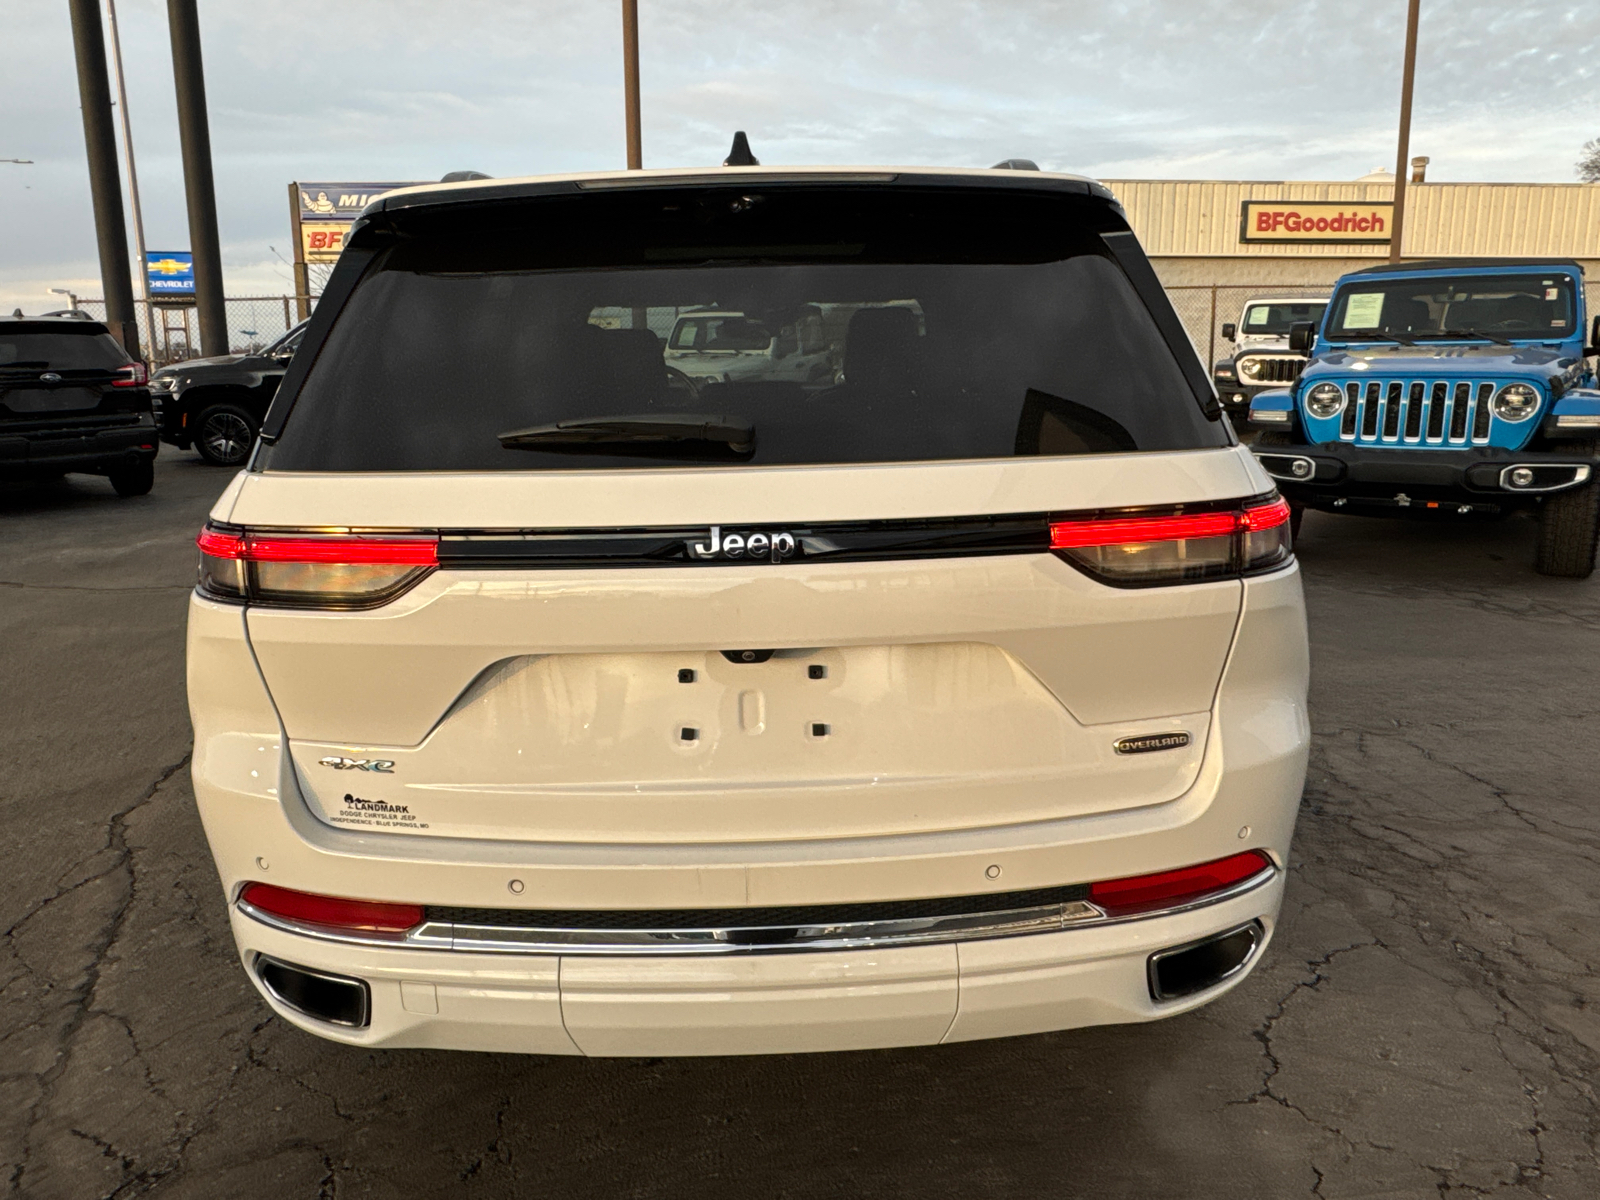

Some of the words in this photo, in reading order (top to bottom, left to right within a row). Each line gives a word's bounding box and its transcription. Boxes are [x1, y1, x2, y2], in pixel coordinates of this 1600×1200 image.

[1256, 211, 1384, 232] BFGoodrich
[694, 526, 795, 563] Jeep
[1119, 736, 1187, 751] OVERLAND
[340, 810, 361, 818] DODGE
[364, 812, 398, 820] CHRYSLER
[355, 803, 409, 814] LANDMARK
